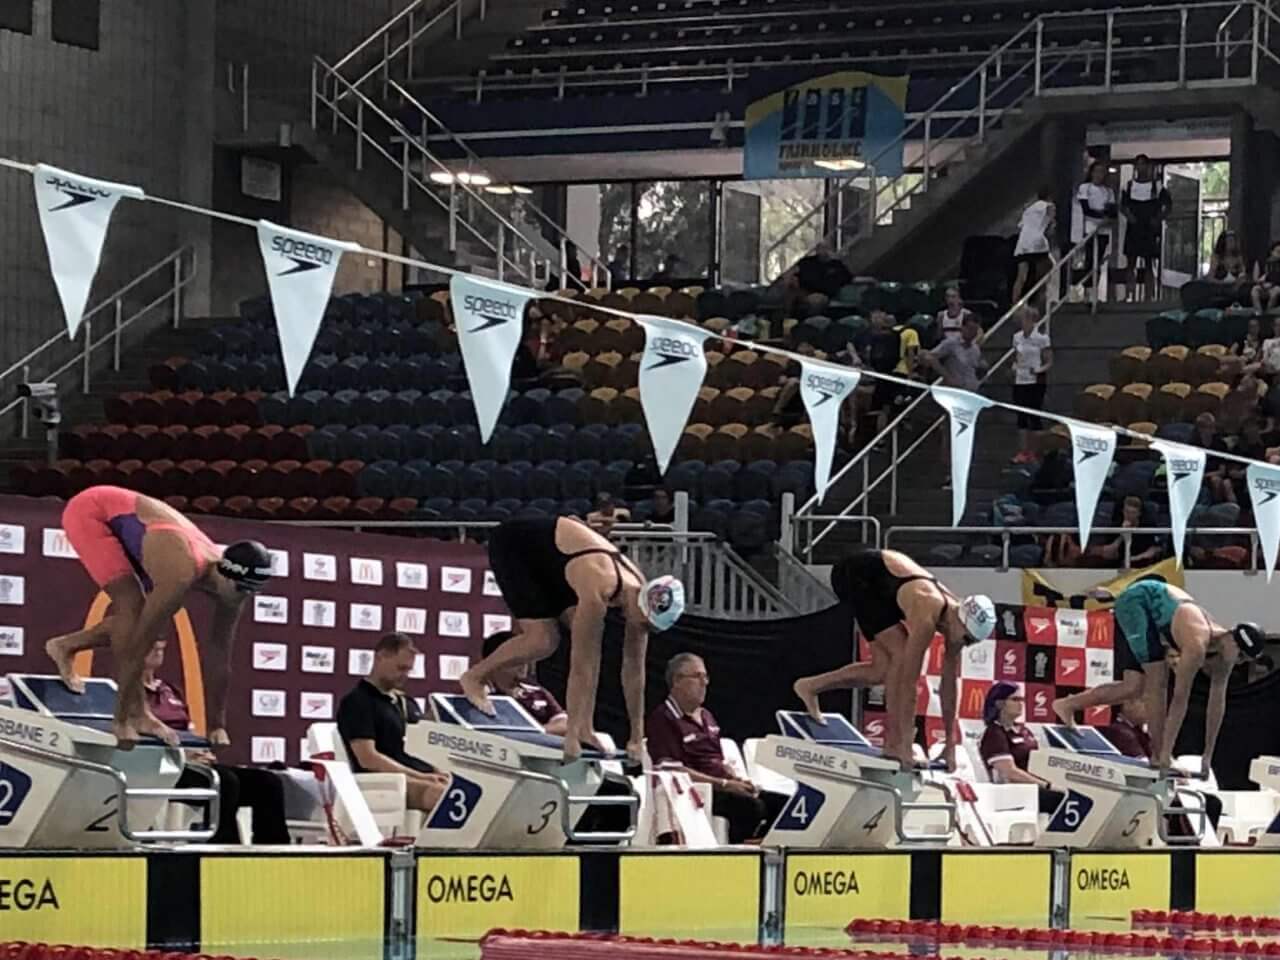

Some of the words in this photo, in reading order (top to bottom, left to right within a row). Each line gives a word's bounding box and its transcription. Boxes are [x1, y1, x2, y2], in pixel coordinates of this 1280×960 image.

[51, 732, 60, 747] 2
[428, 731, 494, 759] BRISBANE
[499, 748, 508, 761] 3
[776, 746, 835, 769] BRISBANE
[840, 758, 848, 769] 4
[1048, 756, 1105, 777] BRISBANE
[1107, 768, 1116, 780] 5
[449, 788, 468, 822] 3
[527, 800, 557, 834] 3
[791, 796, 808, 825] 4
[1064, 801, 1080, 827] 5
[862, 805, 888, 837] 4
[1121, 810, 1147, 838] 5
[427, 874, 514, 903] OMEGA
[794, 870, 860, 896] OMEGA
[1077, 868, 1131, 892] OMEGA
